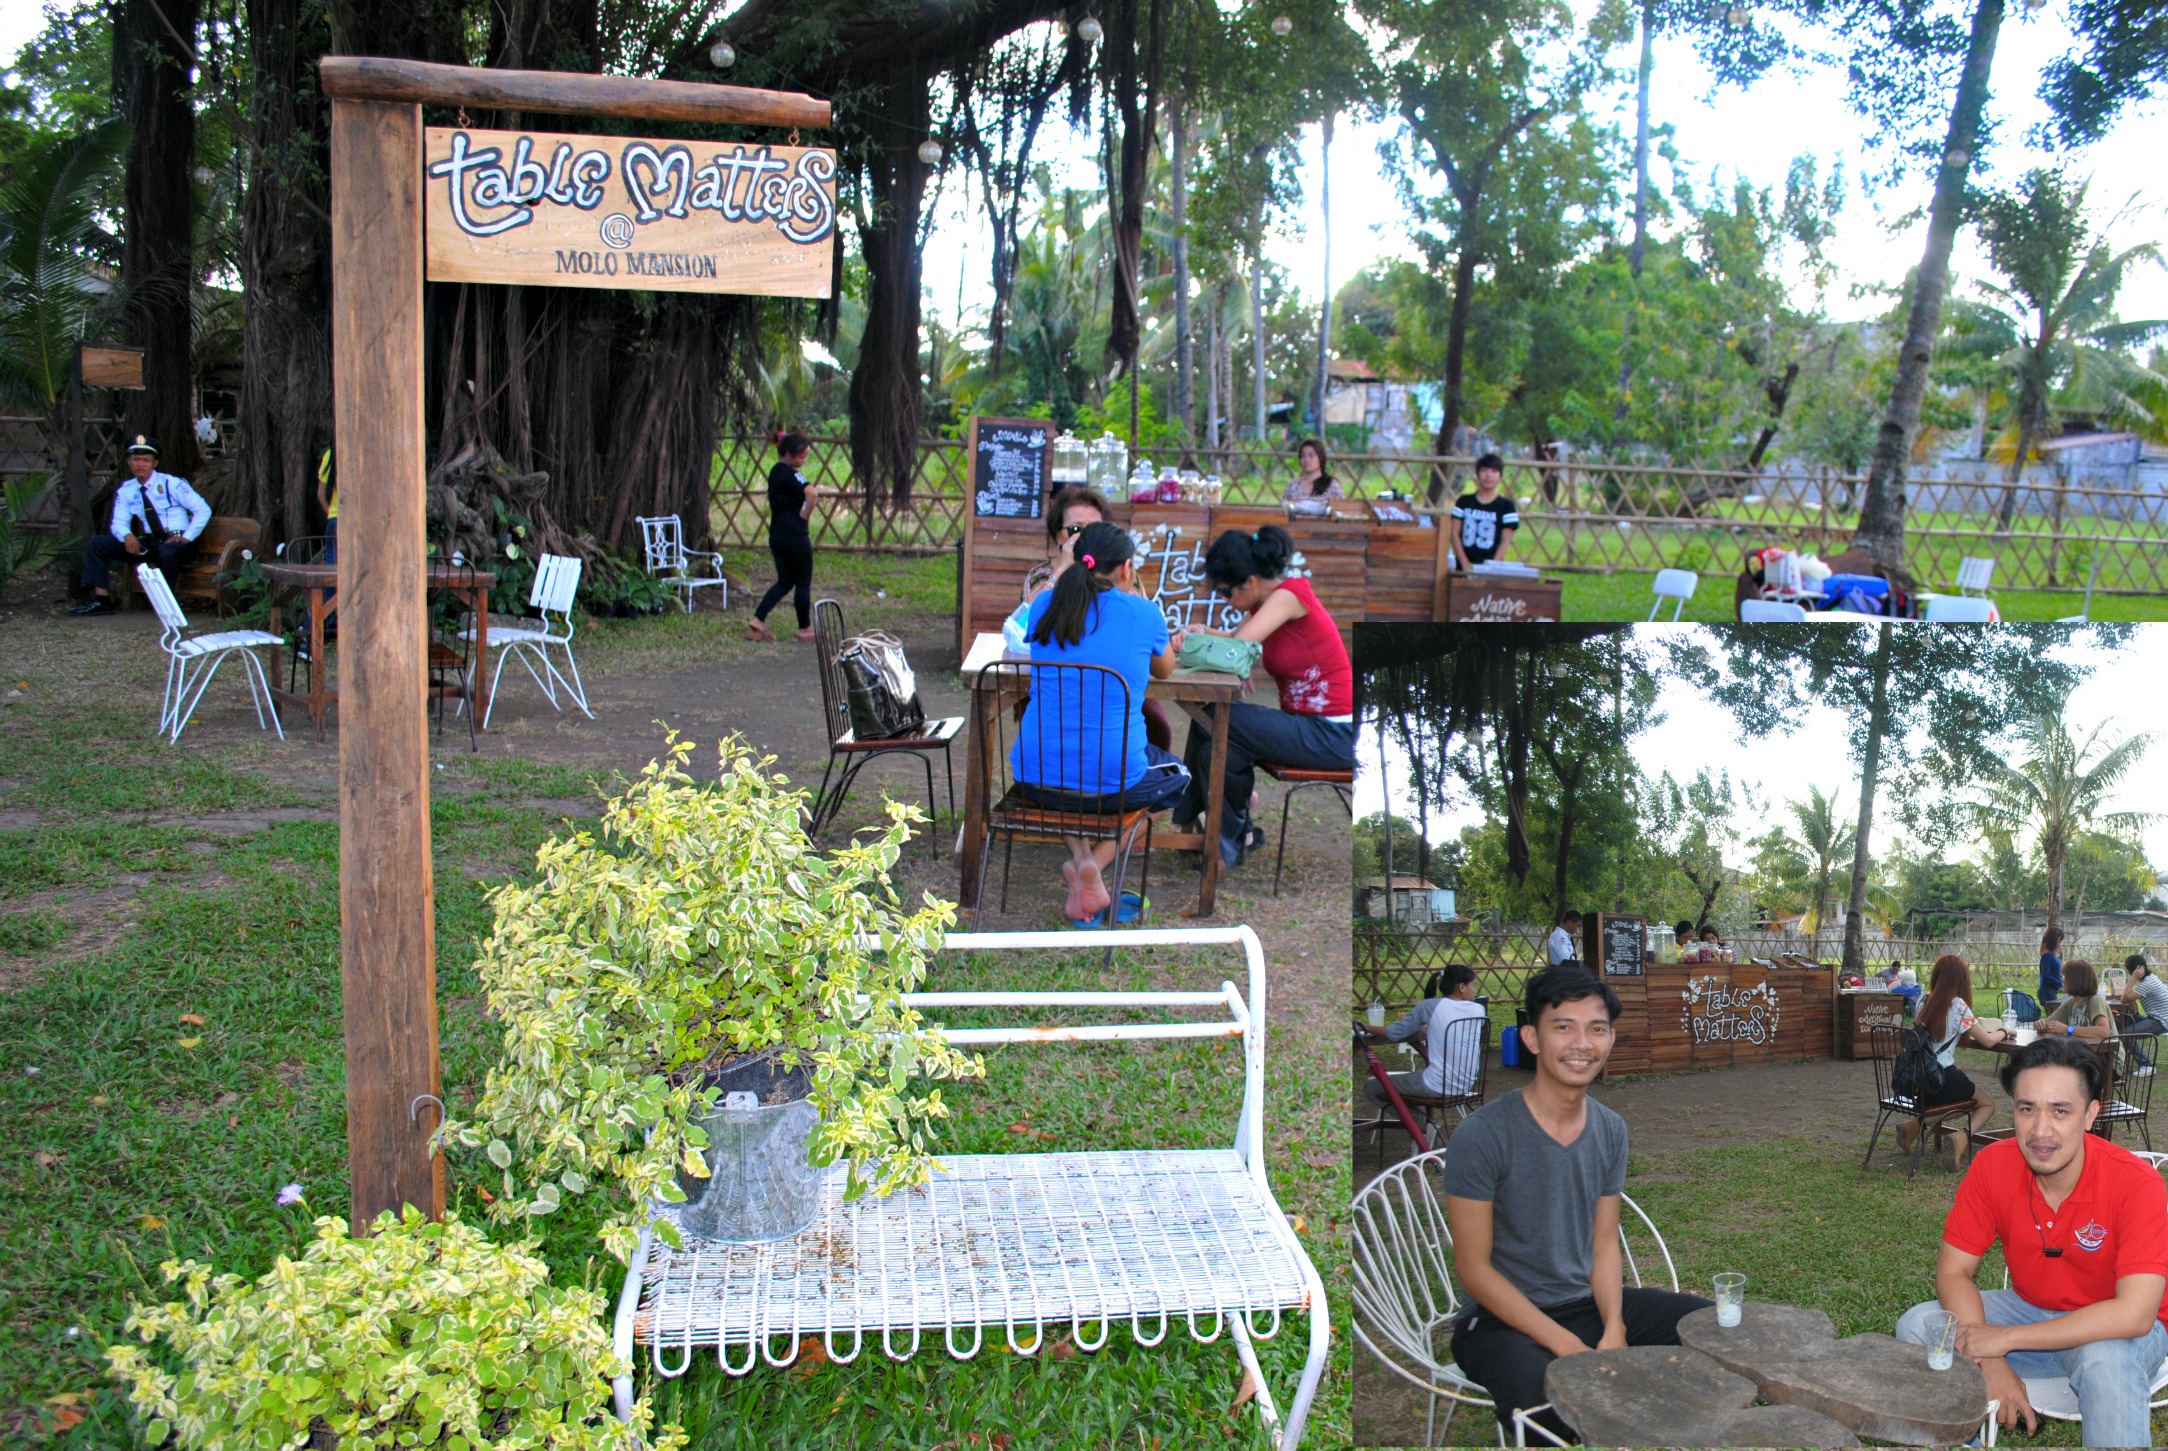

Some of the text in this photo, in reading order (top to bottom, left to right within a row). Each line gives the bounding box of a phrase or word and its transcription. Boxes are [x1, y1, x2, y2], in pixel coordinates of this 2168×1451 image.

[600, 213, 634, 249] @
[555, 250, 718, 279] MOLO MANSION
[1470, 594, 1527, 616] Native
[1863, 1003, 1889, 1014] Native
